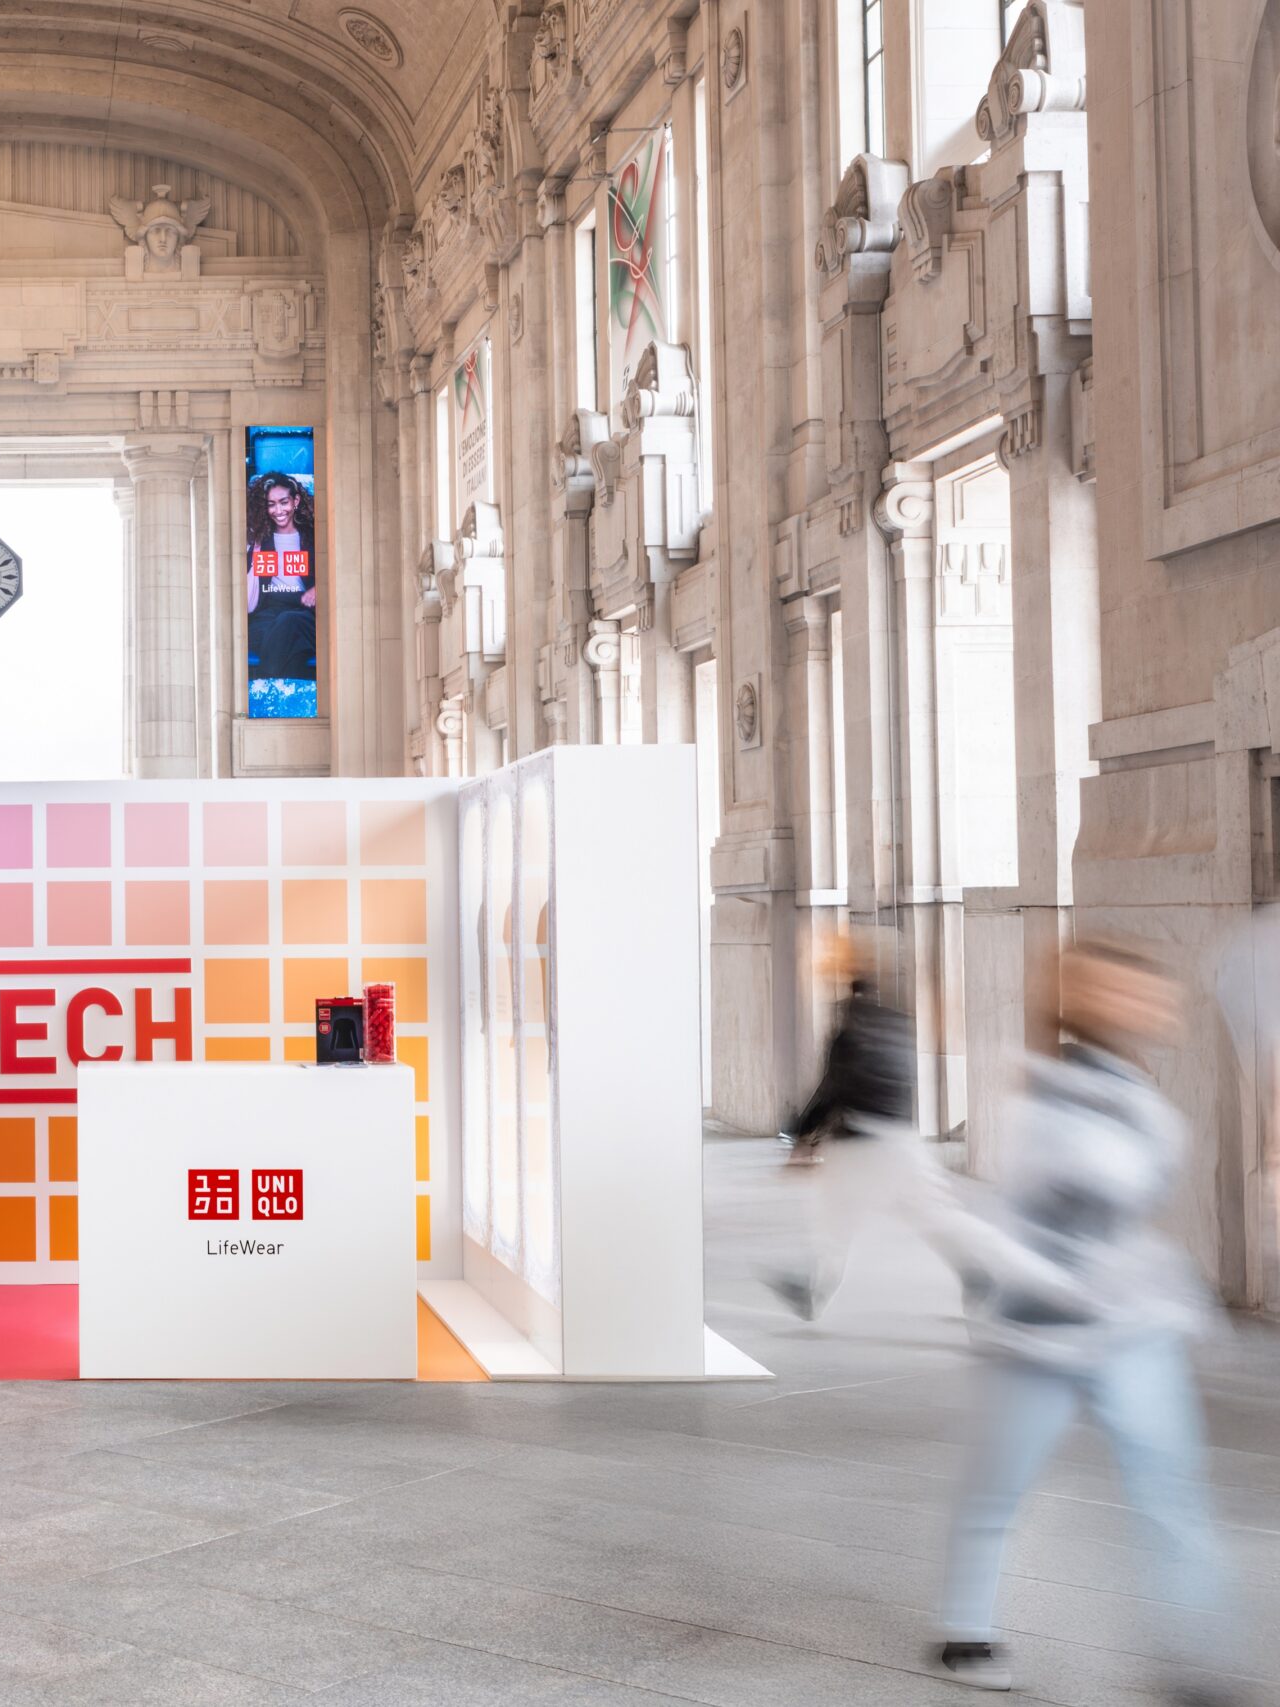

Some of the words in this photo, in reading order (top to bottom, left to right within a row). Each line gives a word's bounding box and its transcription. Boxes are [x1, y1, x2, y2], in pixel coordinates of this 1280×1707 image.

[261, 584, 300, 593] LifeWear
[257, 1175, 294, 1193] UNI
[257, 1196, 298, 1217] QLO
[207, 1239, 284, 1255] LifeWear
